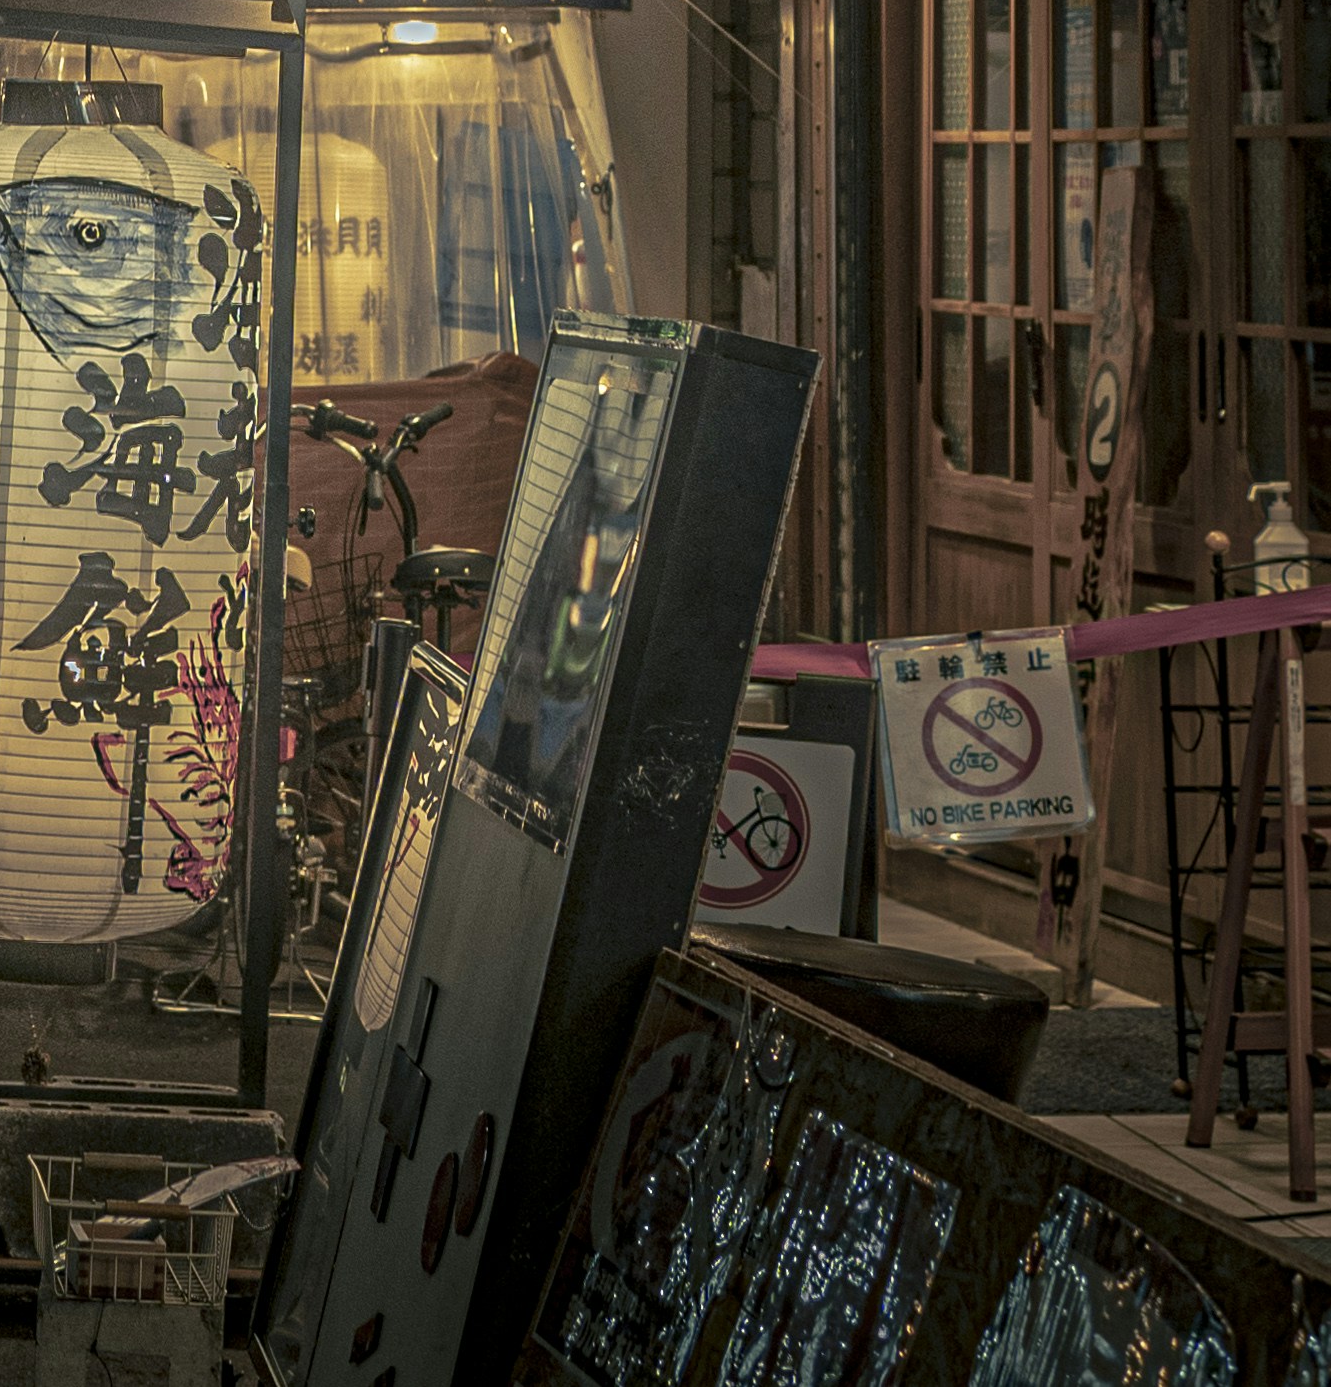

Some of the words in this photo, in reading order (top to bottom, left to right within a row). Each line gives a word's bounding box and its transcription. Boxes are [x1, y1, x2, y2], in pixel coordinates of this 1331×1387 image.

[10, 352, 198, 894] 海鮮
[895, 647, 1052, 683] 駐輪禁止
[911, 807, 938, 827] NO
[942, 803, 985, 825] BIKE
[990, 795, 1074, 821] PARKING
